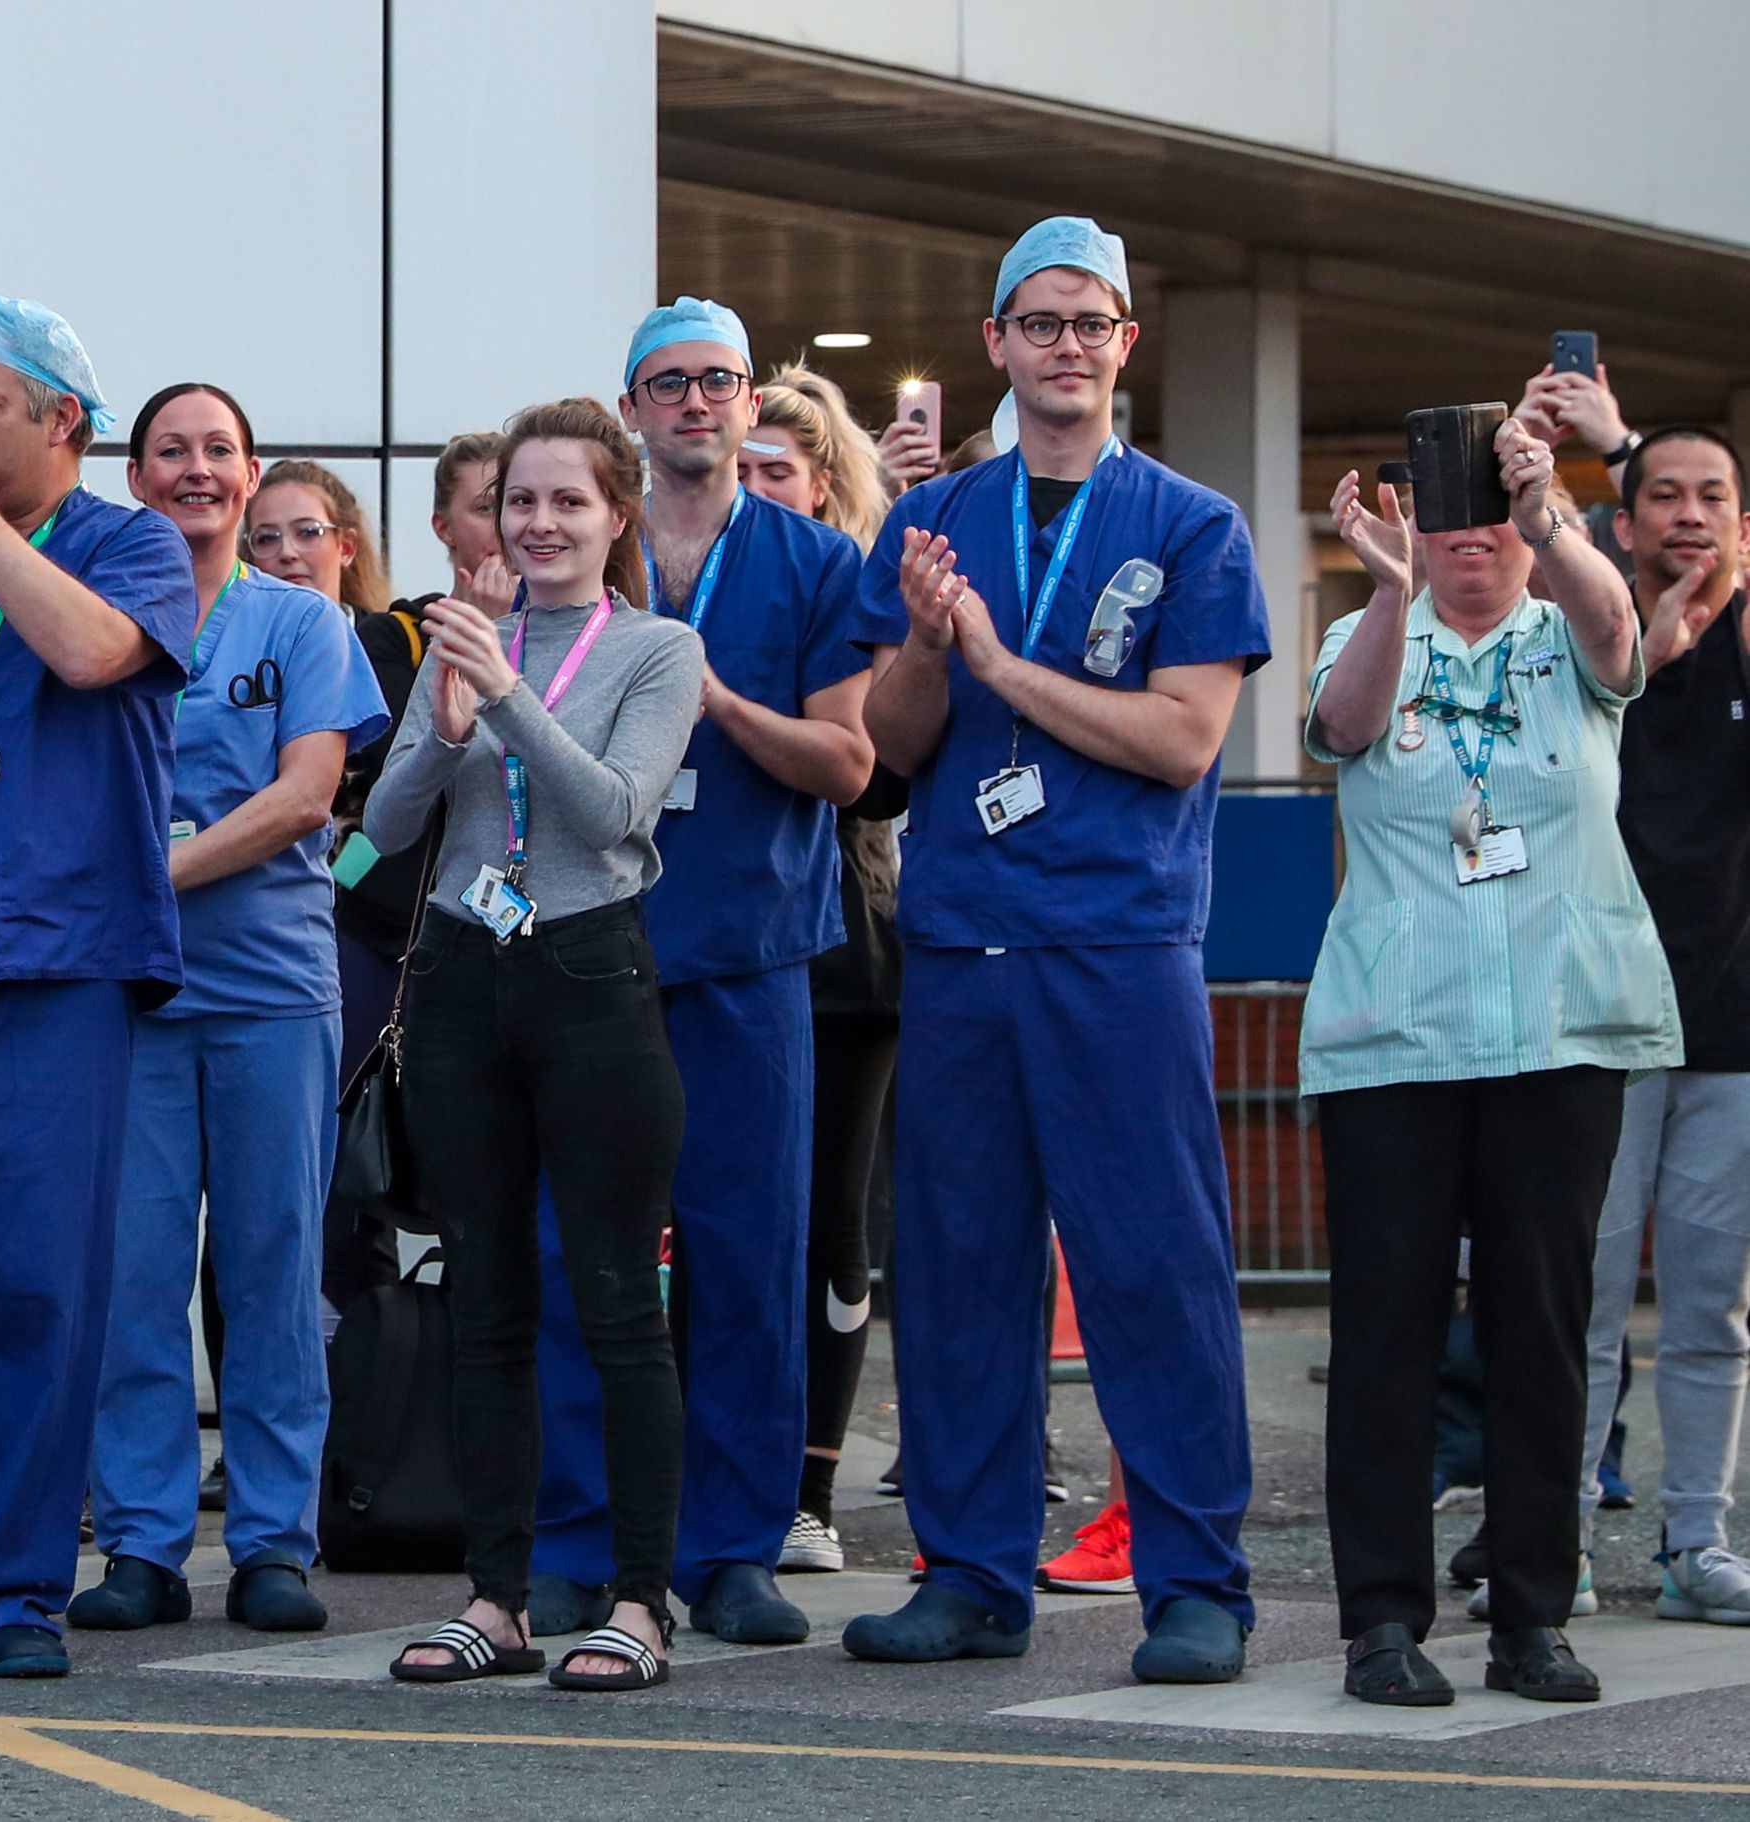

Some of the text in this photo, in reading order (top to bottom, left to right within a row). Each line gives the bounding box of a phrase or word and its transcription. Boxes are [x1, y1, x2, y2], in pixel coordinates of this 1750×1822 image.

[1057, 498, 1085, 561] Critical Care Doctor
[1029, 577, 1057, 646] Critical Care Doctor
[1525, 648, 1550, 663] NHS
[1455, 745, 1469, 766] NHS
[508, 768, 519, 790] NHS
[511, 799, 522, 821] NHS
